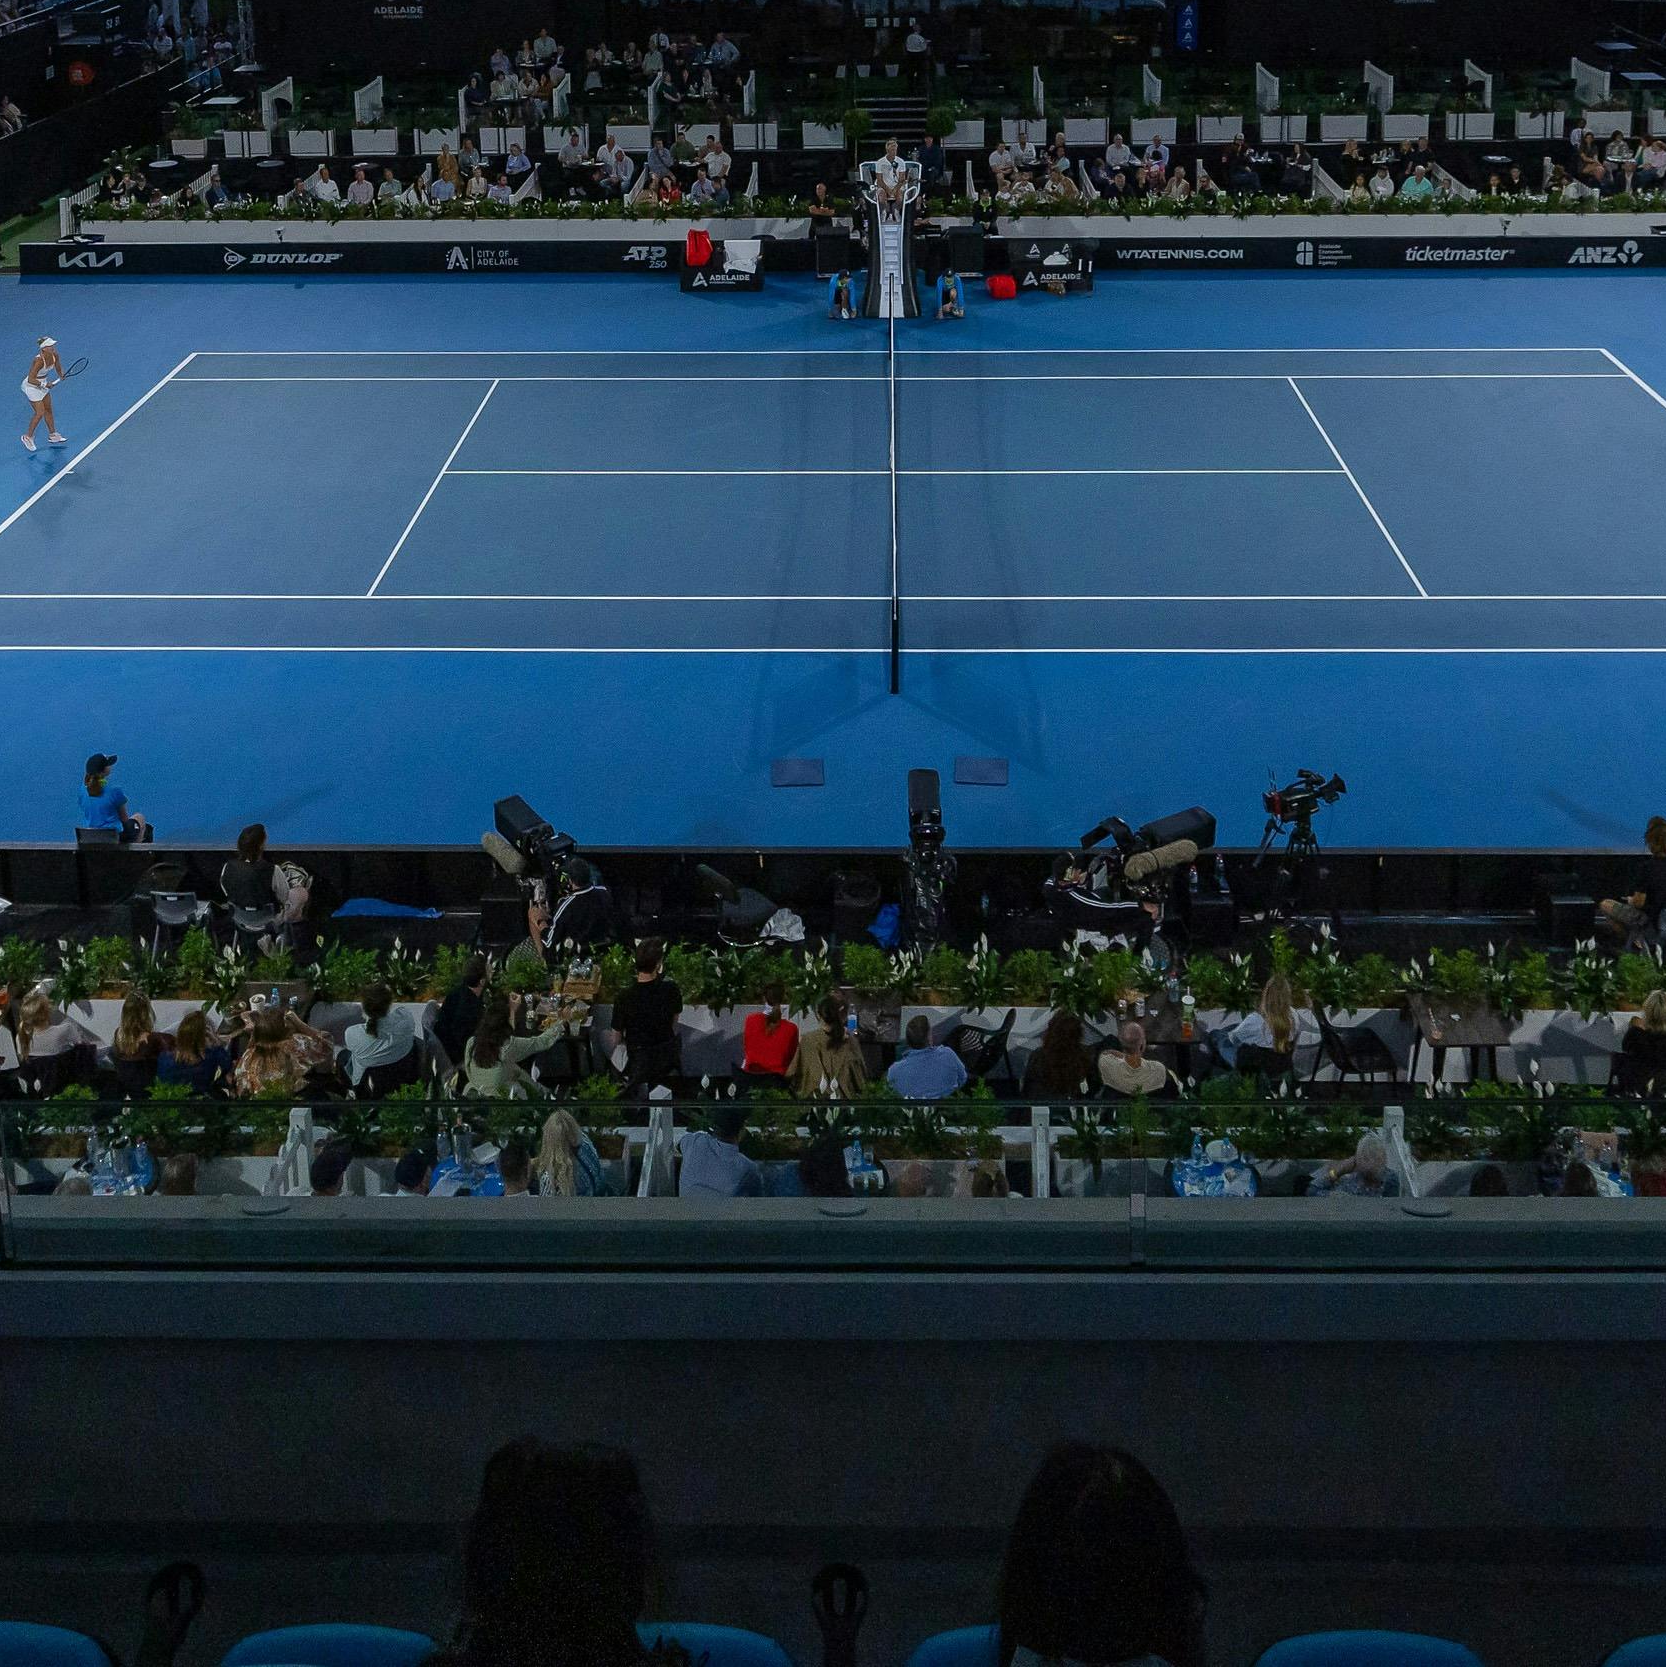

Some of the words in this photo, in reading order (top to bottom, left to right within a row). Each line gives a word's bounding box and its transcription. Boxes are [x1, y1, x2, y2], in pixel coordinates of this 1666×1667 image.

[373, 5, 424, 14] ADELAIDE
[250, 253, 340, 264] DUNLOP
[477, 250, 496, 258] CITY
[499, 250, 510, 258] OF
[622, 246, 667, 261] ATP
[1116, 249, 1244, 260] WTATENNIS.COM
[1405, 246, 1509, 262] ticketmaster
[1568, 246, 1617, 264] ANZ
[477, 258, 520, 266] ADELAIDE
[649, 259, 667, 269] 250
